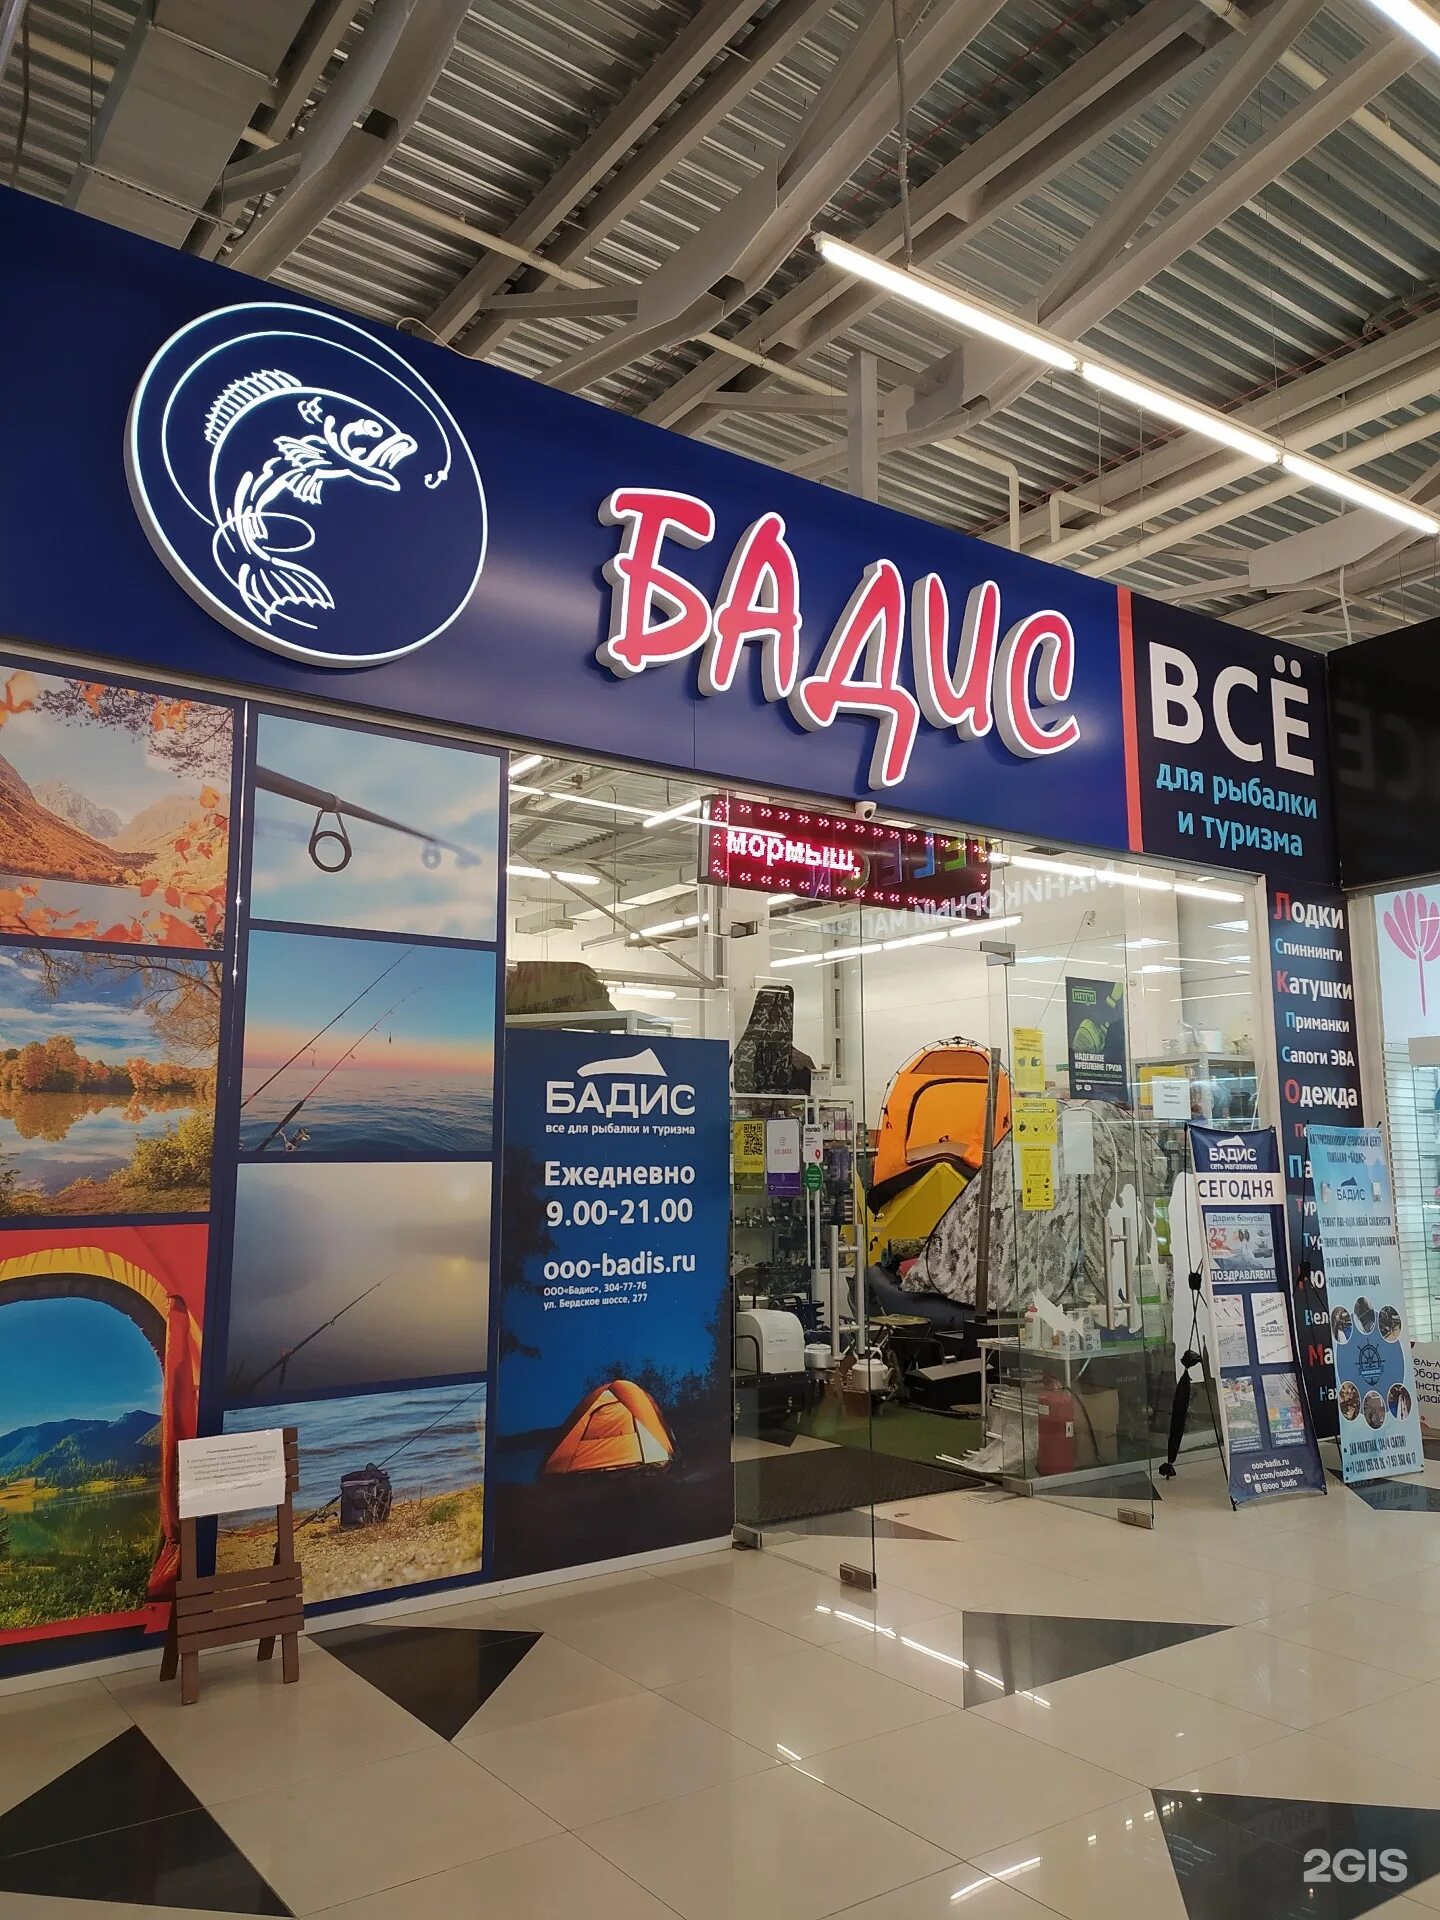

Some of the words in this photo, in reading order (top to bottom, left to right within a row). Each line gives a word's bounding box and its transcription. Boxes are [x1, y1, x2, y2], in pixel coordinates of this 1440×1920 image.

[598, 487, 1081, 789] БАДИС
[1149, 641, 1315, 776] ВСЁ
[1156, 763, 1204, 793] для
[1213, 774, 1318, 819] рыбалки
[1177, 811, 1194, 835] и
[1202, 814, 1303, 856] туризма
[1273, 891, 1344, 930] Лодки
[1275, 937, 1343, 962] Спиннинги
[1276, 970, 1353, 1001] Катушки
[1285, 1011, 1350, 1033] Приманки
[1281, 1046, 1328, 1066] Сапоги
[1330, 1049, 1355, 1067] ЭВА
[545, 1080, 696, 1119] БАДИС
[1284, 1079, 1358, 1109] Одежда
[545, 1124, 565, 1133] все
[567, 1124, 588, 1134] для
[591, 1123, 640, 1136] рыбалки
[643, 1125, 650, 1134] и
[652, 1125, 695, 1136] туризма
[1208, 1147, 1257, 1163] БАДИС
[544, 1161, 696, 1188] Ежедневно
[1197, 1179, 1274, 1199] СЕГОДНЯ
[1337, 1188, 1365, 1201] БАДИС
[546, 1198, 693, 1227] 9.00-21.00
[1212, 1214, 1236, 1222] Дарим
[1237, 1214, 1264, 1223] бонусы!
[1209, 1227, 1227, 1242] 23
[543, 1251, 696, 1280] ooo-badis.ru
[603, 1281, 647, 1293] 304-77-76
[543, 1301, 557, 1311] ул.
[559, 1298, 600, 1309] Бердское
[602, 1296, 630, 1305] шоссе,
[632, 1293, 648, 1303] 277
[1261, 1325, 1284, 1333] БАДИС
[1252, 1459, 1290, 1470] ooo-badis.ru
